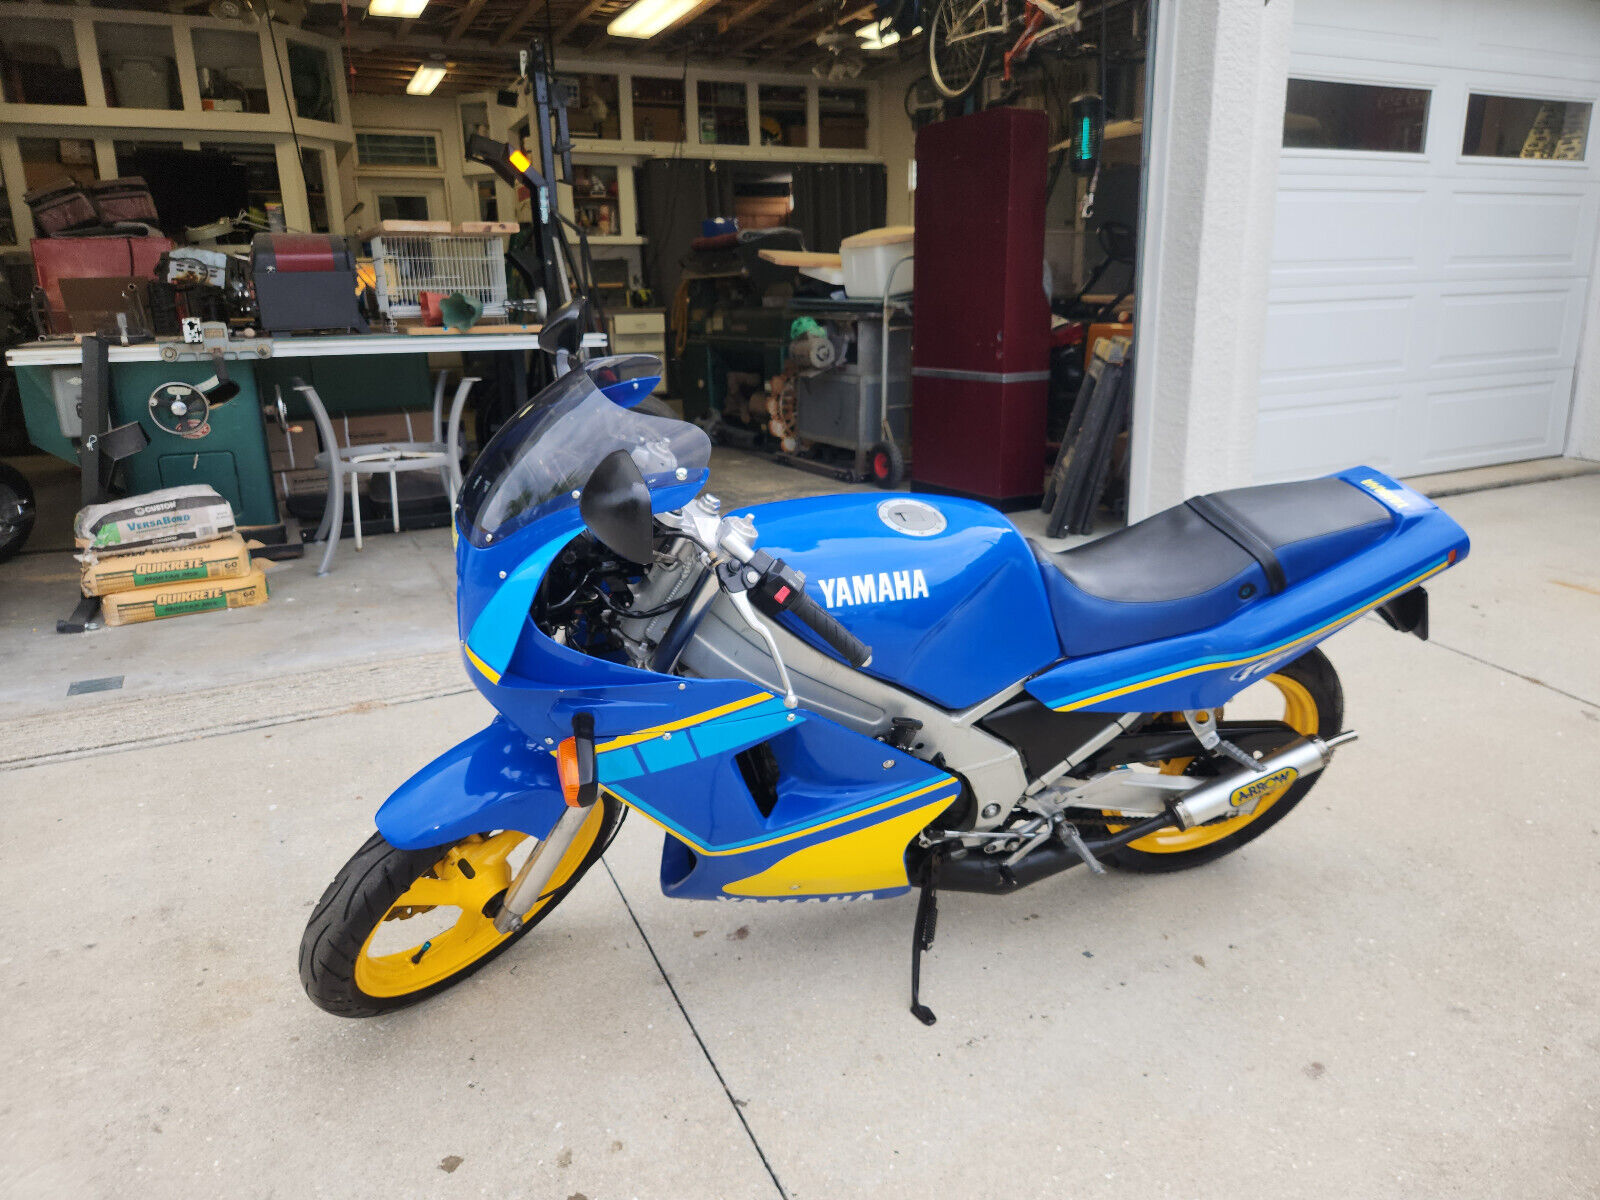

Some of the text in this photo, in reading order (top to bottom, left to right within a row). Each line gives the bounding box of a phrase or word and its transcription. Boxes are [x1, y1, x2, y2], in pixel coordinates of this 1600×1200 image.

[144, 500, 177, 513] CUSTOM
[135, 557, 205, 576] QUIKRETE
[156, 586, 223, 606] QUIKRETE
[818, 569, 930, 609] YAMAHA
[1238, 770, 1290, 802] ARROW
